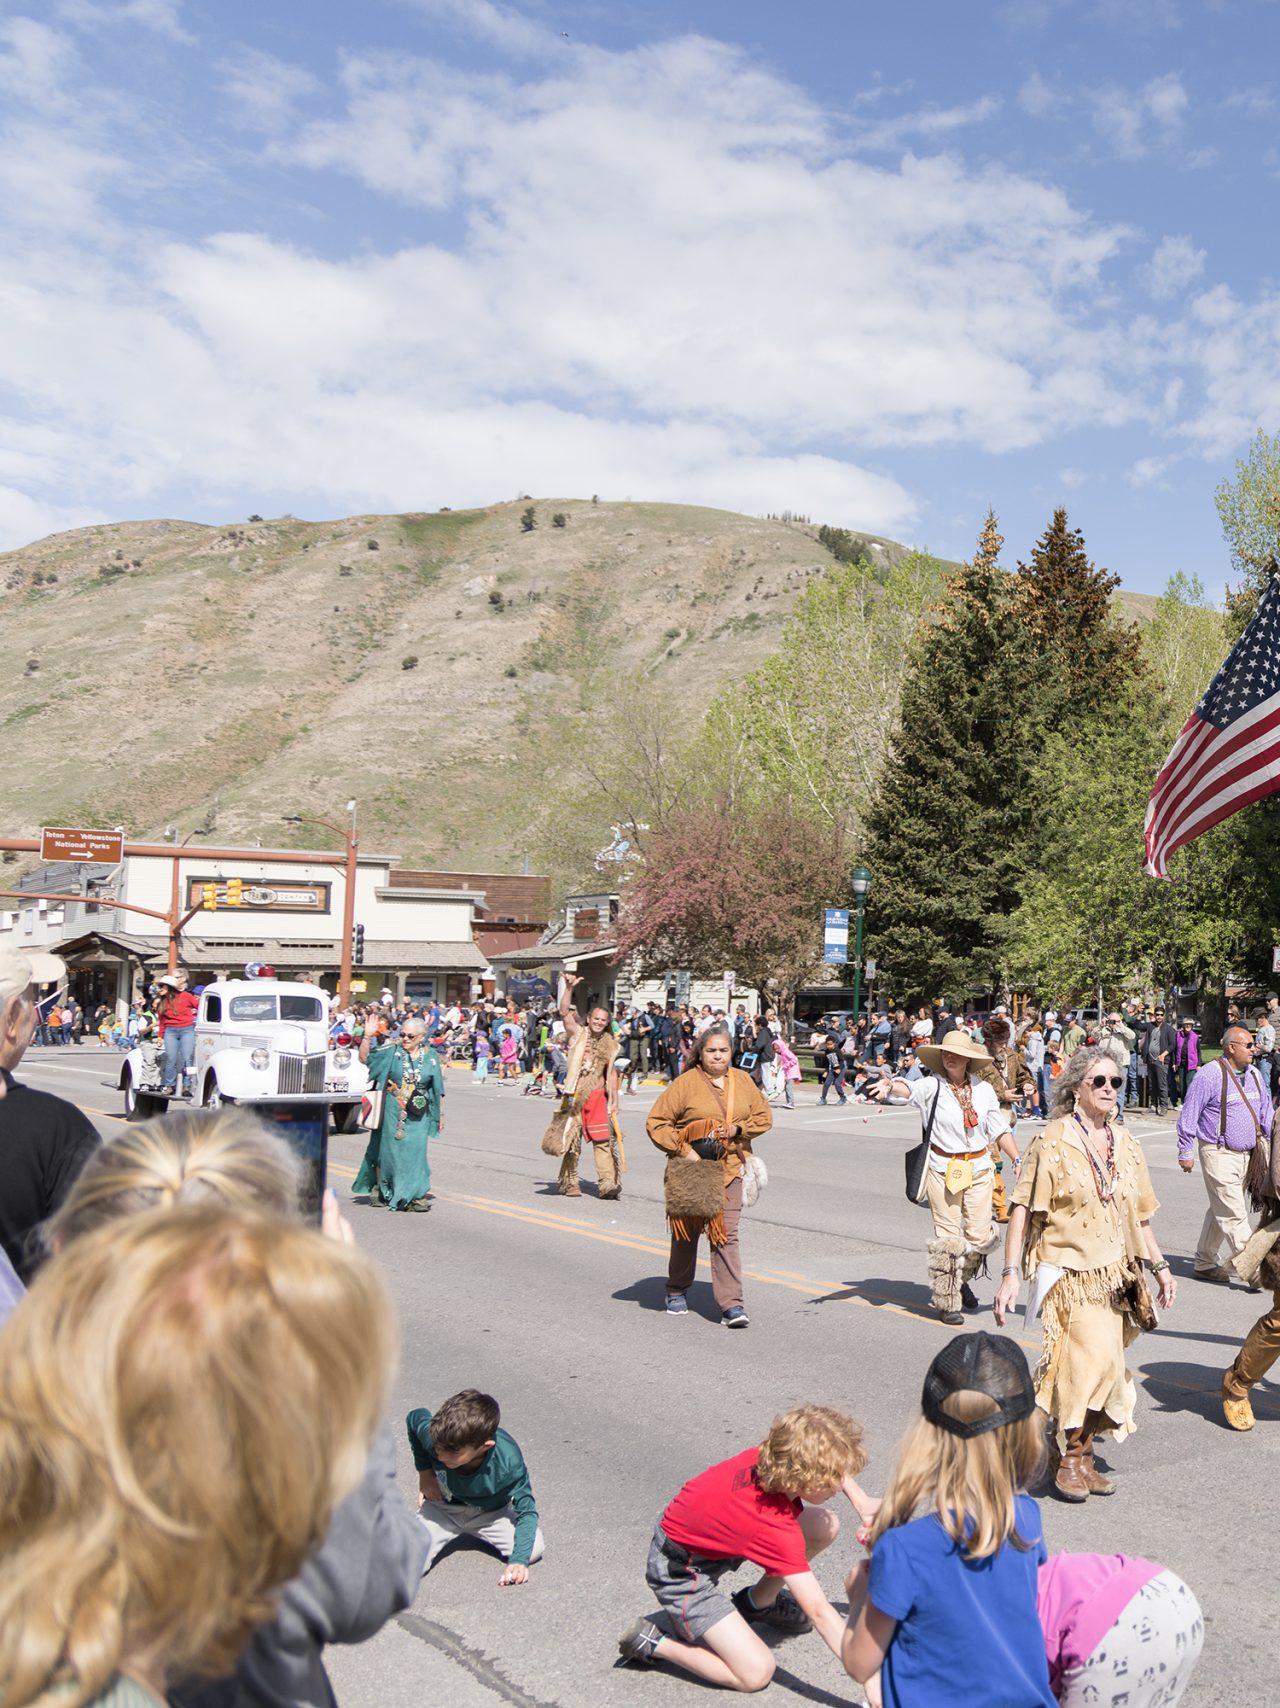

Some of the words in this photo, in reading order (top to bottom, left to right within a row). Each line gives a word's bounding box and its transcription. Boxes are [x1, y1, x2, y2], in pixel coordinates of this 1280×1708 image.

[45, 831, 65, 839] Teton
[80, 833, 122, 842] Yellowstone
[55, 841, 86, 849] National
[90, 842, 111, 850] Parks
